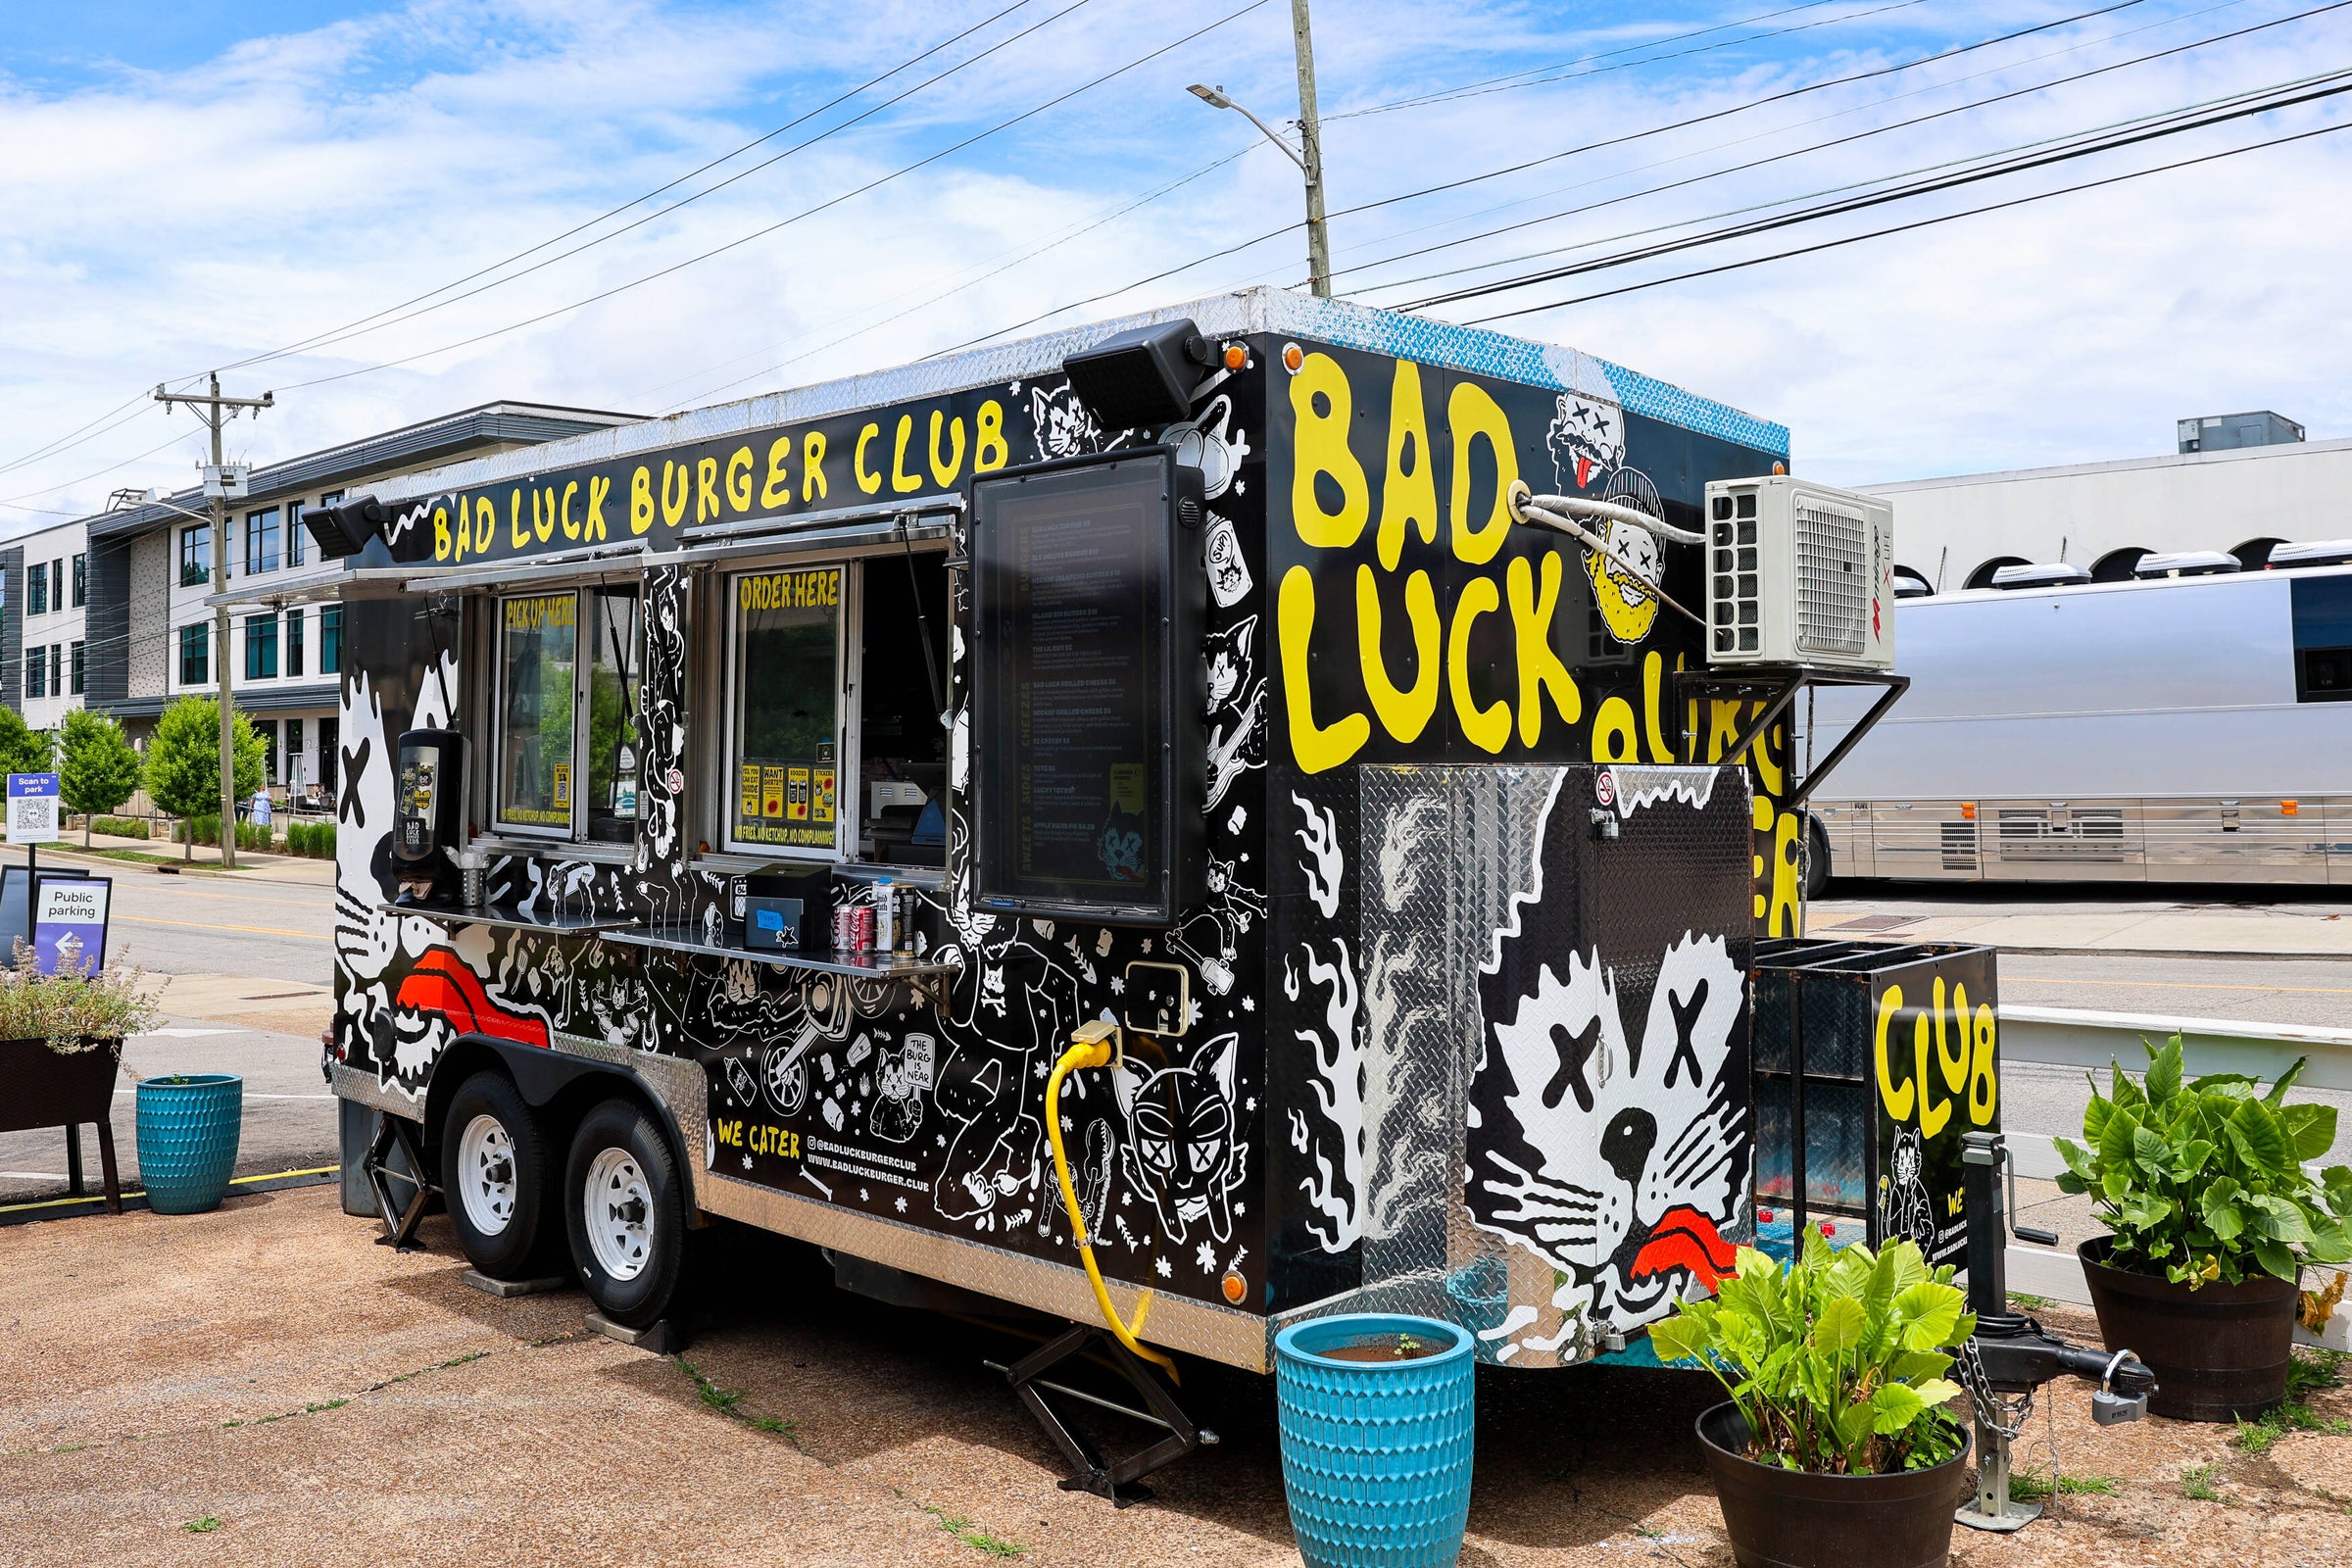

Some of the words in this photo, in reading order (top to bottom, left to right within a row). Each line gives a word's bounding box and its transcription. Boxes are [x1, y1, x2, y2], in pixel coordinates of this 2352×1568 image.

[1290, 353, 1518, 571] BAD
[433, 498, 495, 562] BAD
[509, 476, 612, 549] LUCK
[629, 431, 827, 535] BURGER
[855, 399, 1009, 494] CLUB
[740, 573, 791, 611] ORDER
[795, 570, 839, 608] HERE
[506, 600, 529, 628] PICK
[530, 598, 546, 628] UP
[547, 596, 575, 627] HERE
[1278, 550, 1582, 774] LUCK
[19, 777, 39, 786] Scan
[764, 768, 783, 778] WANT
[24, 786, 43, 795] park
[48, 906, 95, 918] parking
[54, 891, 93, 903] Public
[906, 1049, 931, 1062] BURG
[910, 1039, 927, 1052] THE
[1875, 976, 1995, 1140] CLUB
[907, 1070, 929, 1084] NEAR
[914, 1061, 921, 1070] IS
[717, 1117, 743, 1147] WE
[749, 1125, 800, 1159] CATER
[816, 1138, 917, 1172] @BADLUCKBURGERCLUB
[808, 1152, 930, 1193] WWW.BADLUCKBURGER.CLUB
[1947, 1186, 1964, 1217] WE
